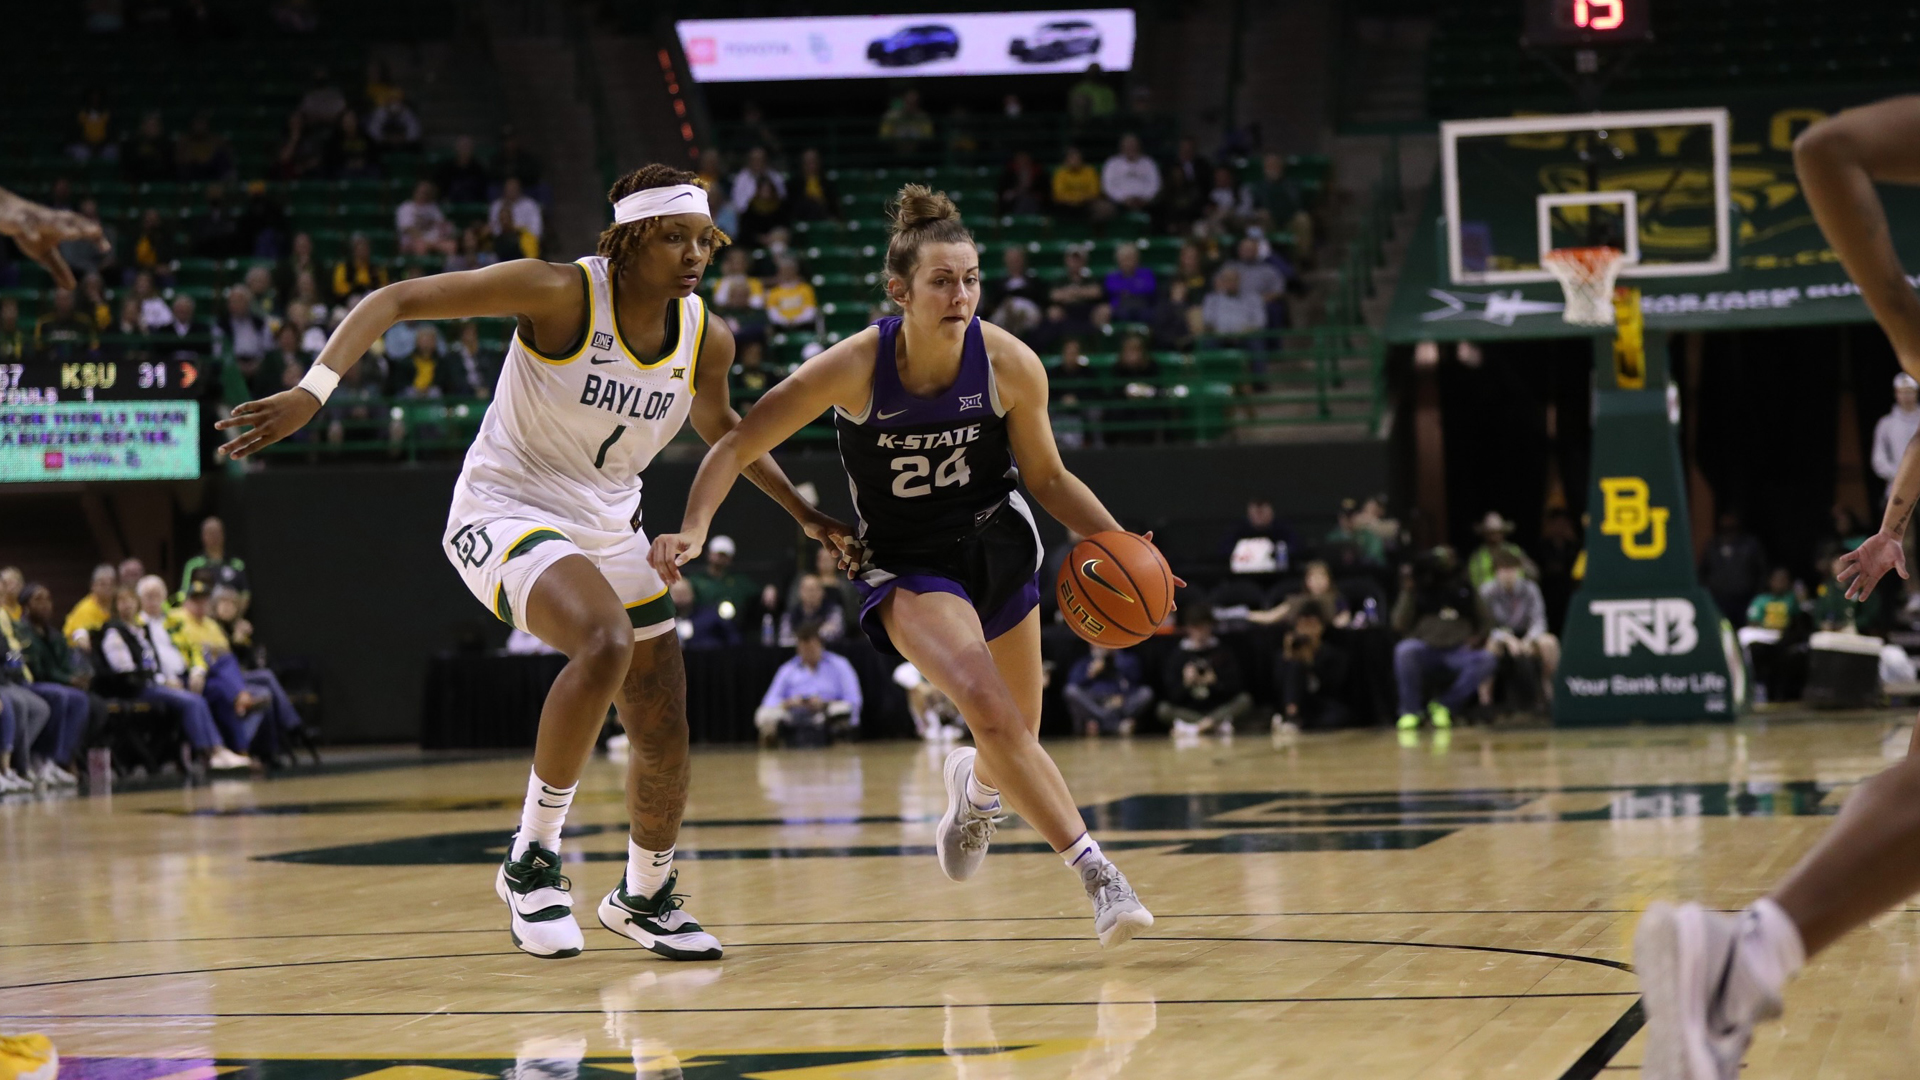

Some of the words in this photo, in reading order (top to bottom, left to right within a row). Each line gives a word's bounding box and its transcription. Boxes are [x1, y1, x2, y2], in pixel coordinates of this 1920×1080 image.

[594, 333, 612, 347] ONE
[61, 362, 117, 389] KSU
[138, 362, 167, 388] 31
[579, 373, 675, 421] BAYLOR
[594, 424, 627, 469] 1
[877, 423, 981, 449] K-STATE
[890, 446, 971, 498] 24
[1599, 476, 1669, 559] BU
[1060, 579, 1106, 636] ELITE
[1565, 676, 1608, 696] Your
[1610, 674, 1659, 695] Bank
[1660, 672, 1688, 694] for
[1689, 671, 1727, 694] Life
